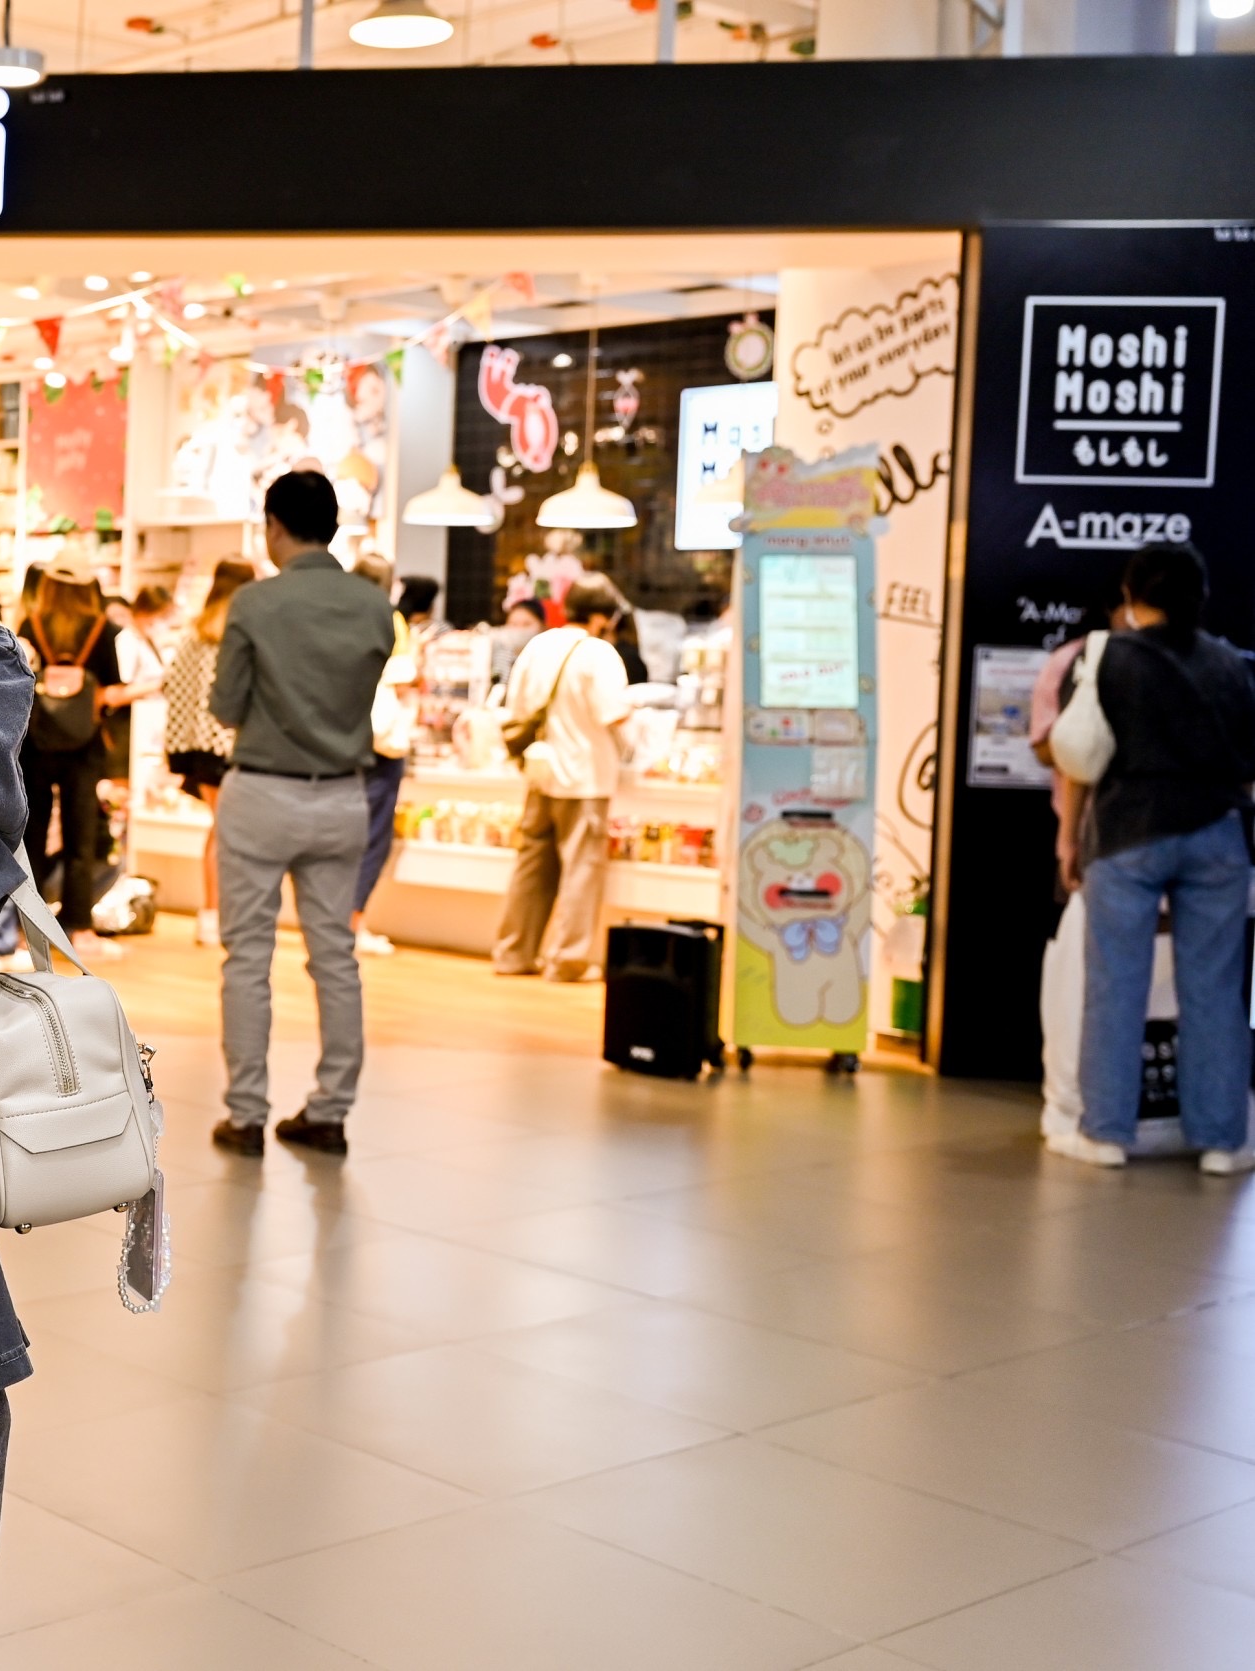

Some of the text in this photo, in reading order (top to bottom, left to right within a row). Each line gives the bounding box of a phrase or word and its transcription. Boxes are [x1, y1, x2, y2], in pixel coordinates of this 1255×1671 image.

[1057, 324, 1187, 368] Moshi
[1053, 370, 1185, 415] Moshi
[1072, 436, 1169, 468] もしもし
[1026, 503, 1192, 549] A-maze
